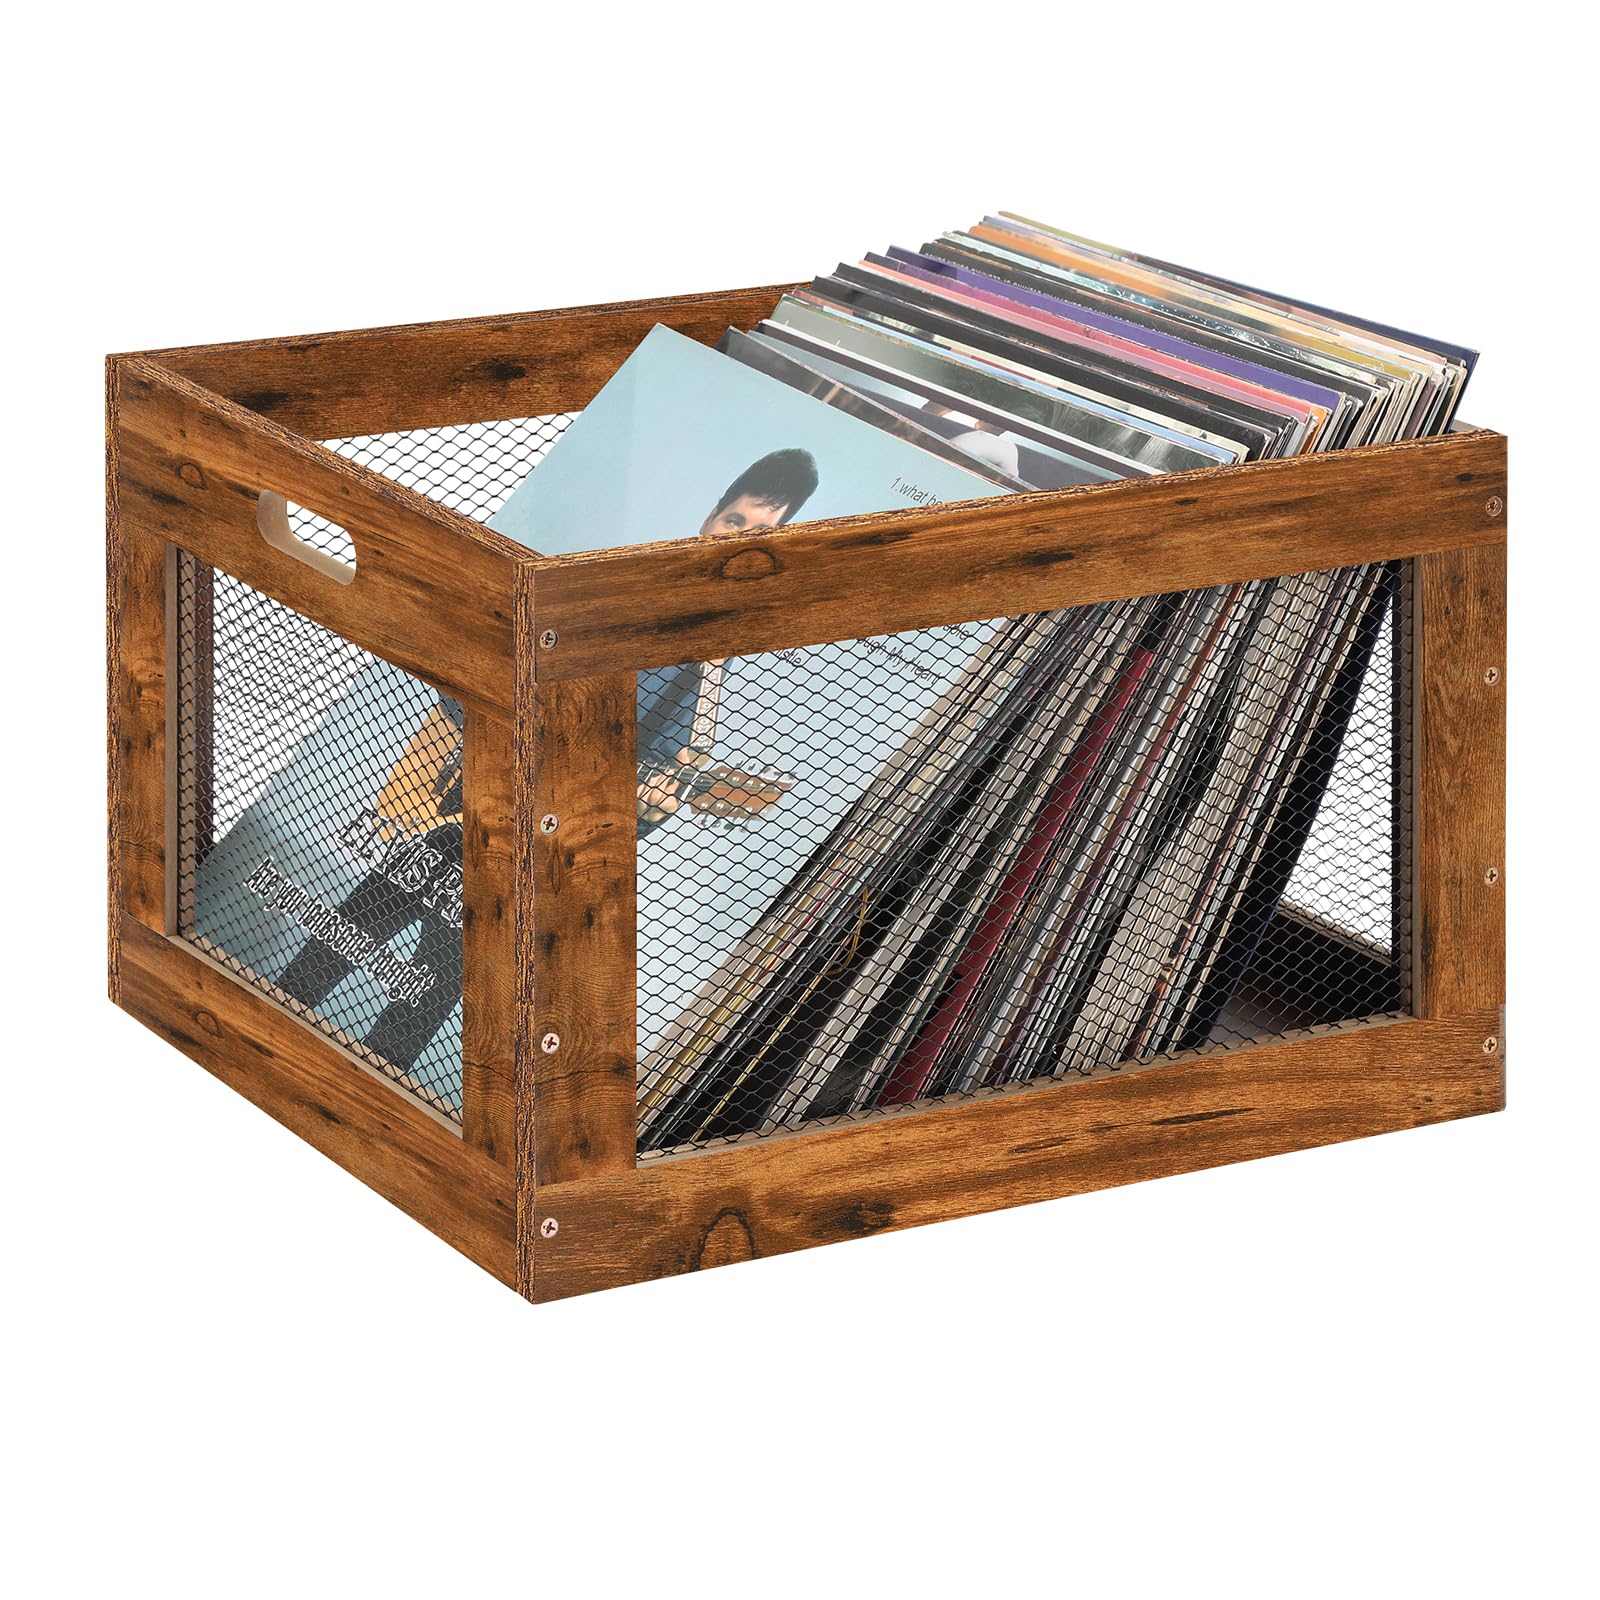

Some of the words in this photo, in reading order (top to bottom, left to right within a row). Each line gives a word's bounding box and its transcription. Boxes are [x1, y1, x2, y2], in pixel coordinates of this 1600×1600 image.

[904, 656, 942, 685] Heart
[242, 854, 283, 899] Are
[263, 877, 310, 918] you
[295, 889, 377, 966] lonesome
[366, 939, 438, 1008] tonight
